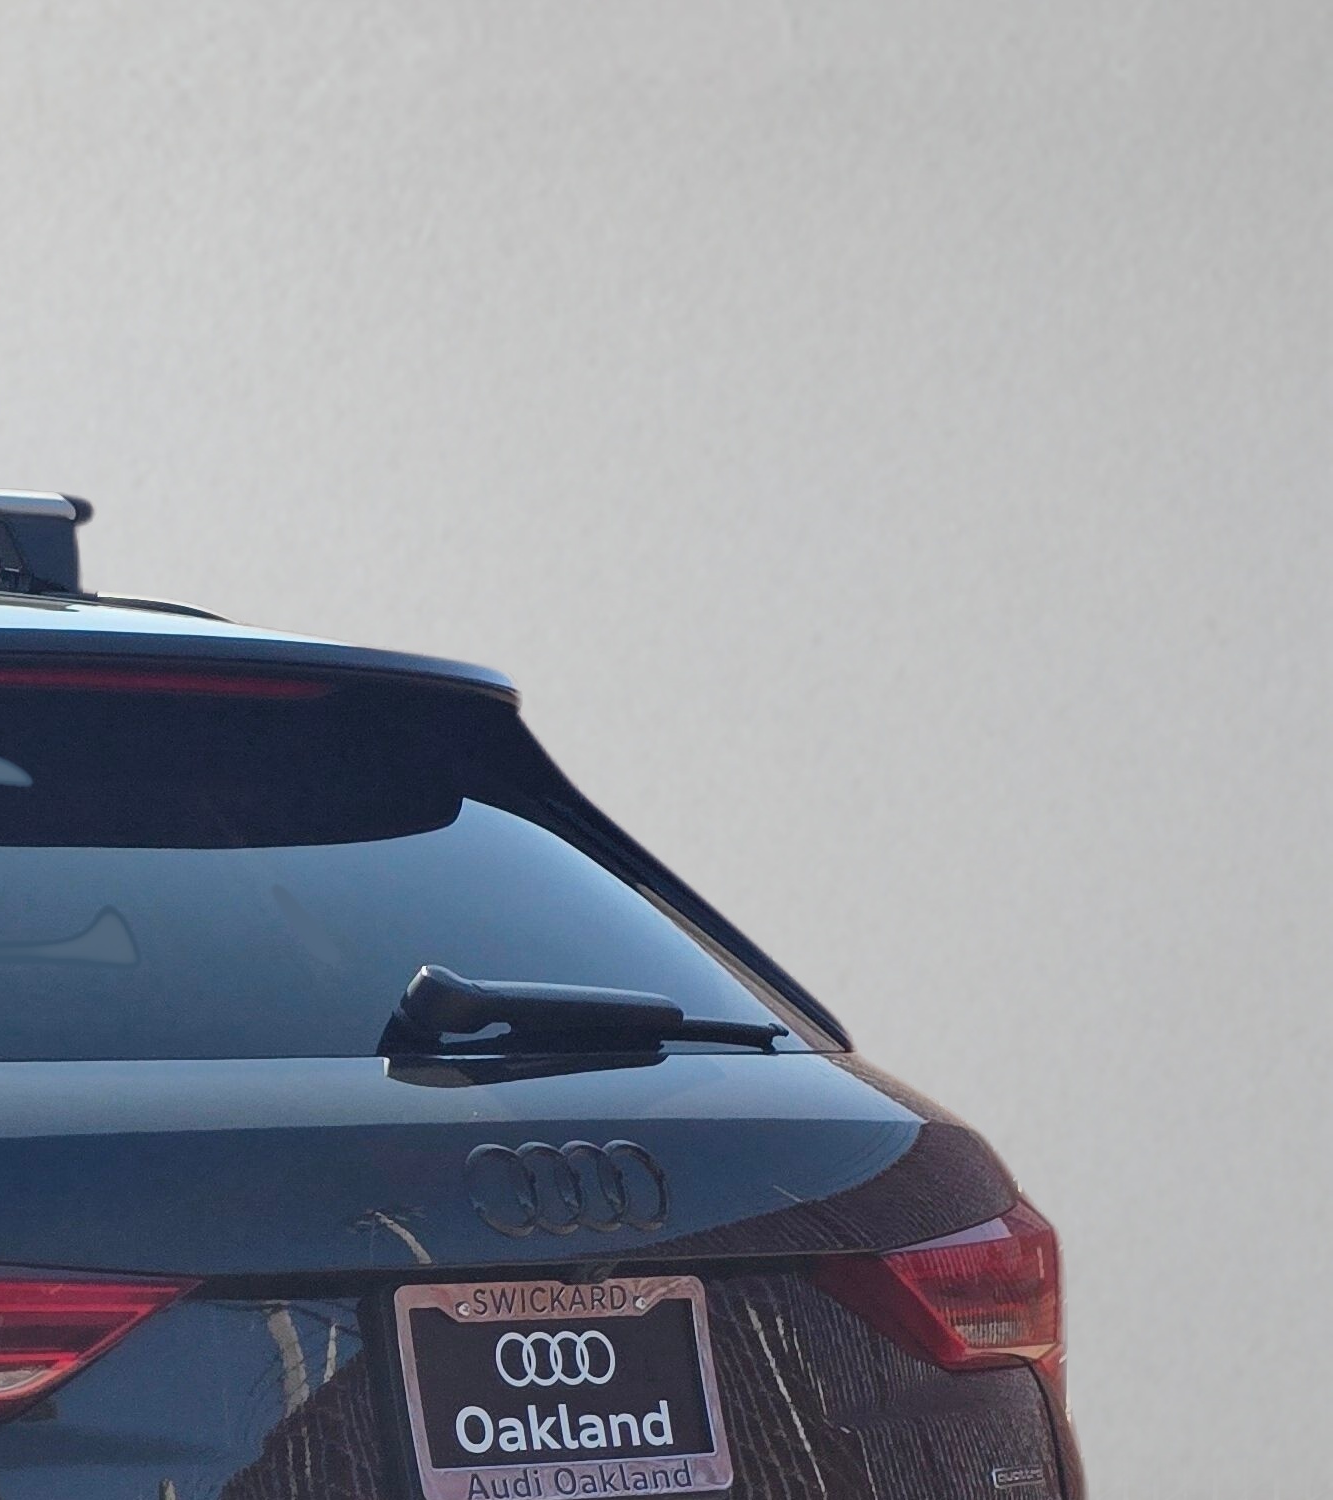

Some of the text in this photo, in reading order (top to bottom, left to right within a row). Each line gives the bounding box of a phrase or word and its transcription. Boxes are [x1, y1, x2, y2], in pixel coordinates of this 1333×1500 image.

[472, 1285, 627, 1316] SWICKARD
[455, 1399, 674, 1454] Oakland
[467, 1459, 693, 1500] Audi Oakland
